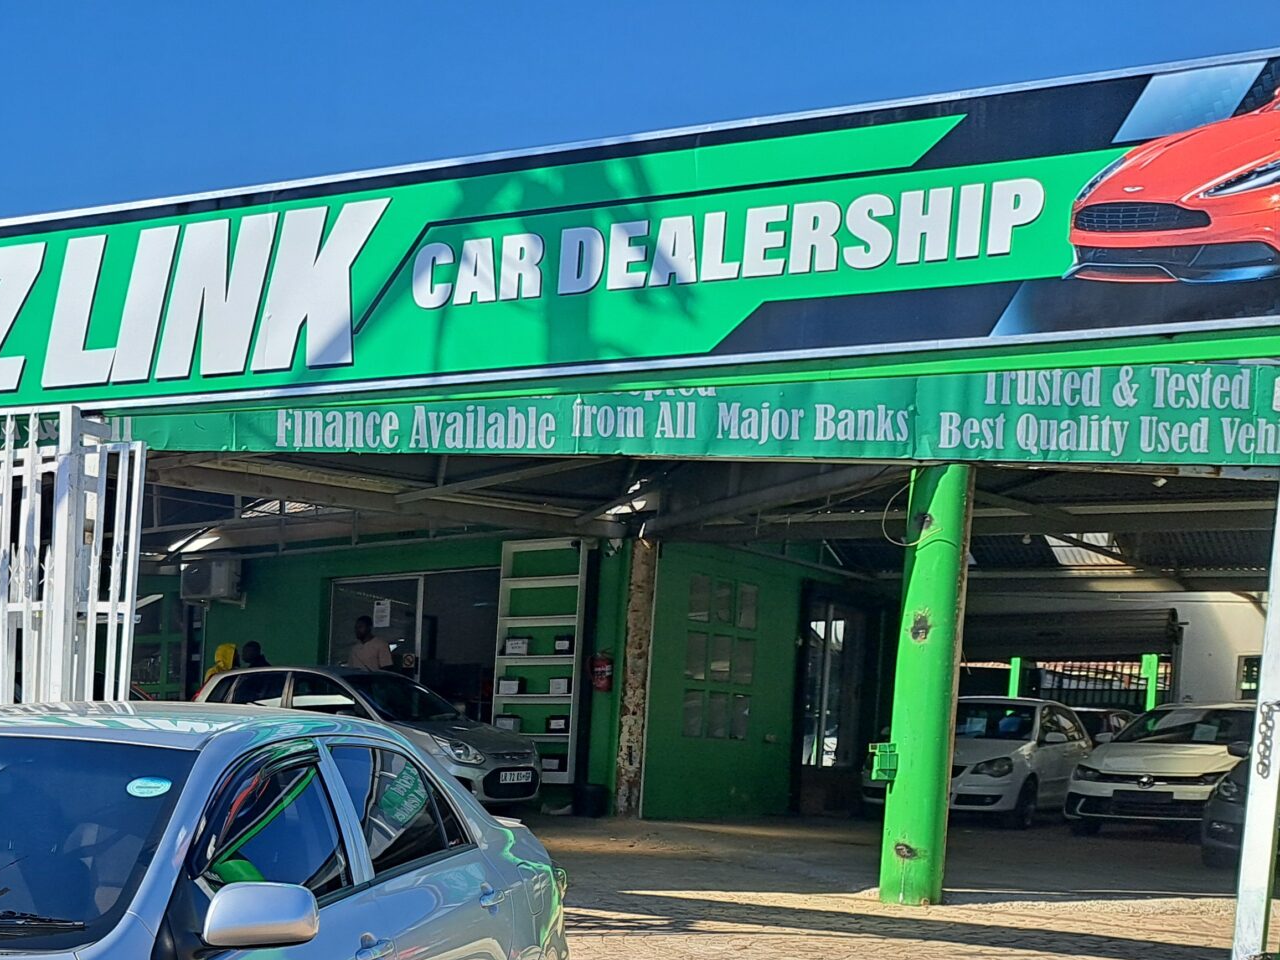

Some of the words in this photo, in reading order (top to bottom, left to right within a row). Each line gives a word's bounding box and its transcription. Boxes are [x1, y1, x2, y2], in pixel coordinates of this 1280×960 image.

[411, 233, 544, 309] CAR
[557, 178, 1045, 295] DEALERSHIP
[41, 198, 392, 387] LINK
[984, 367, 1101, 407] Trusted
[1112, 366, 1139, 407] &
[1151, 367, 1250, 409] Tested
[275, 409, 399, 448] Finance
[409, 405, 556, 449] Available
[572, 402, 644, 439] from
[655, 401, 696, 439] All
[717, 402, 805, 445] Major
[814, 403, 910, 442] Banks
[939, 412, 1005, 449] Best
[1016, 413, 1129, 456] Quality
[1140, 416, 1209, 454] Used
